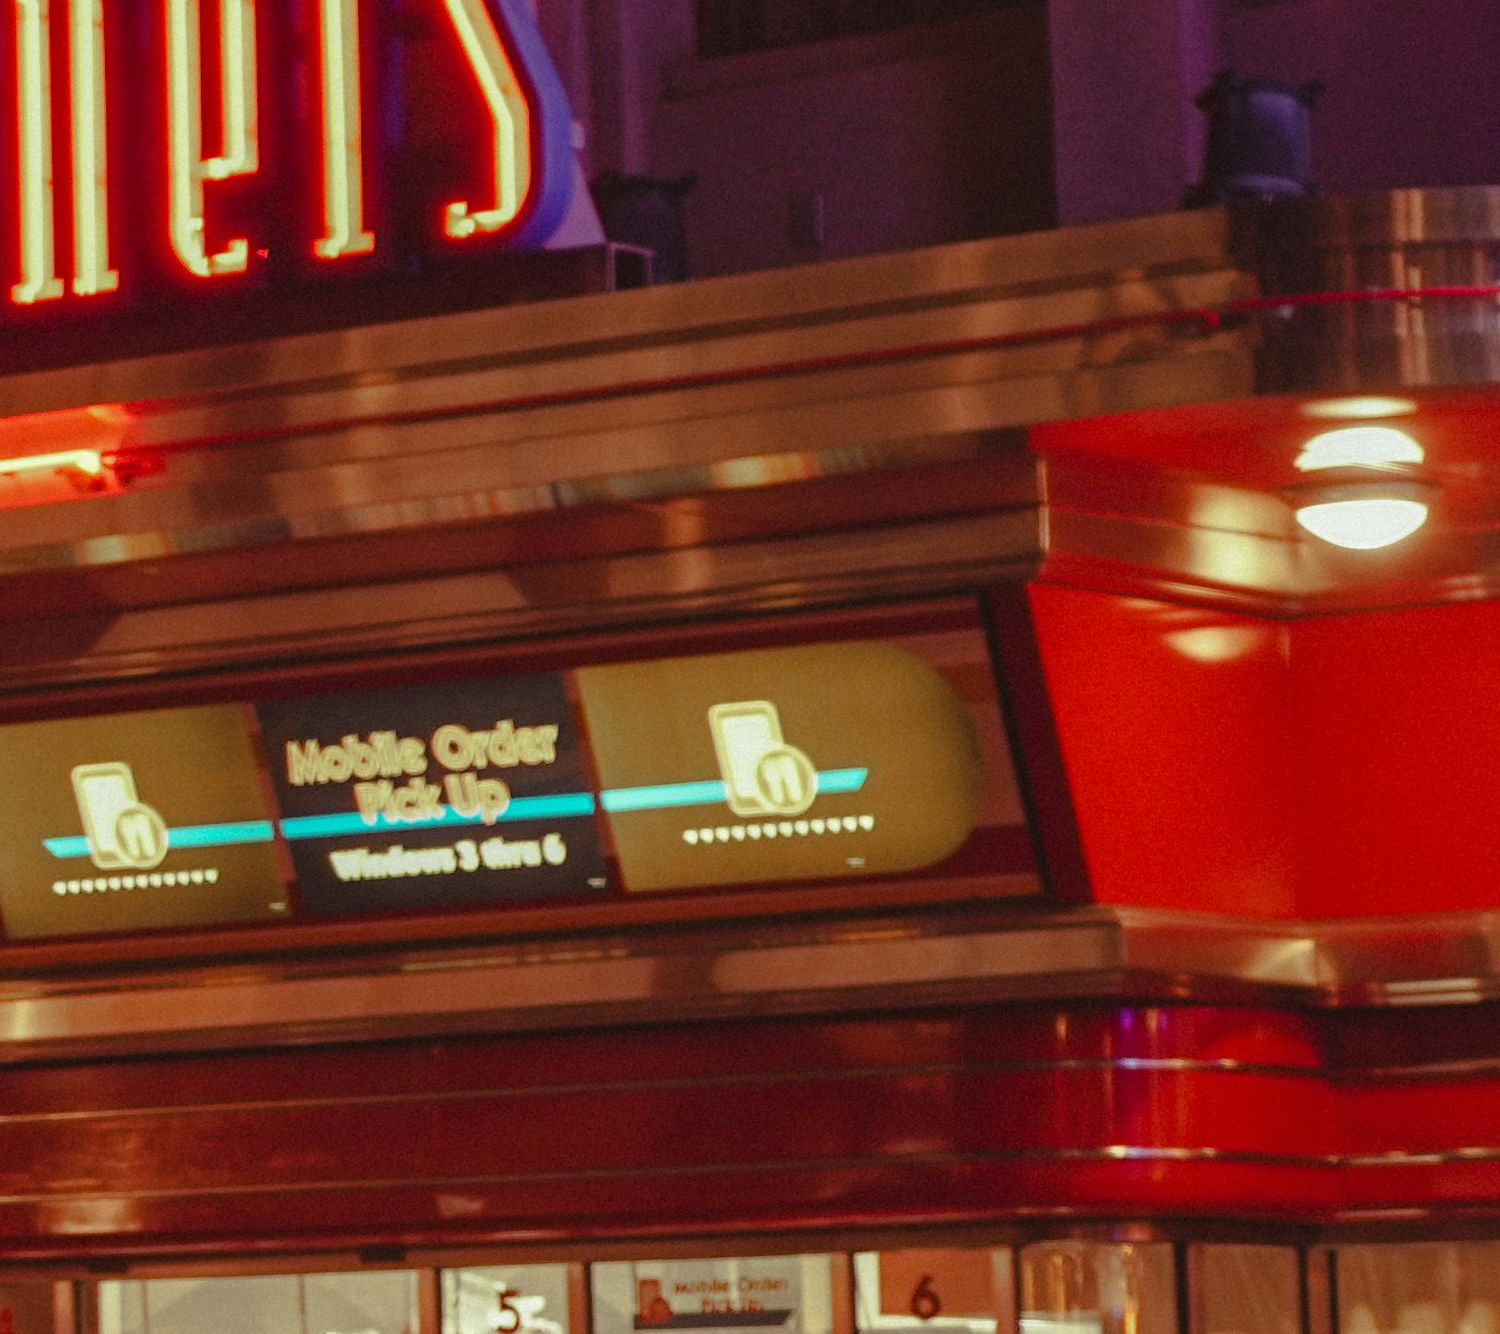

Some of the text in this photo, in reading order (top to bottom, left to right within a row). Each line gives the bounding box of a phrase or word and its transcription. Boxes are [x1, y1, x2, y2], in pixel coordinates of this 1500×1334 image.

[285, 718, 560, 786] Mobile Order
[353, 770, 512, 826] Pick Up
[329, 843, 457, 882] Windows
[455, 838, 481, 873] 3
[542, 831, 568, 866] 6
[498, 1289, 521, 1334] 5
[910, 1275, 942, 1321] 6
